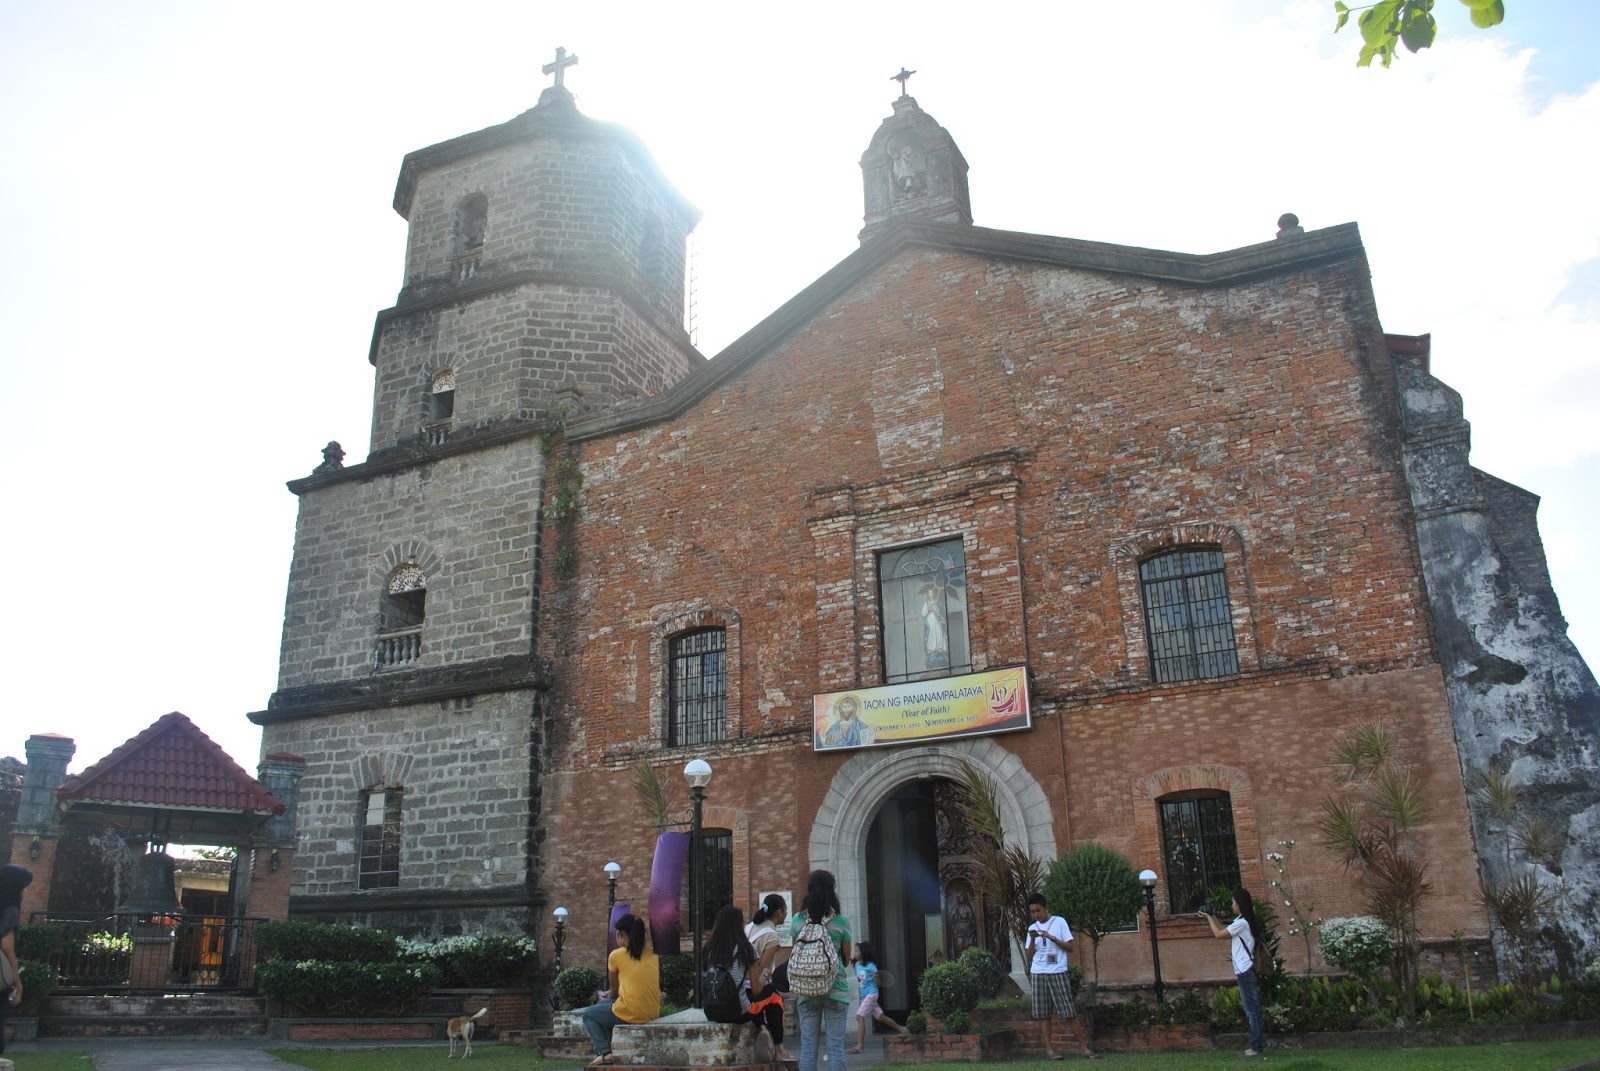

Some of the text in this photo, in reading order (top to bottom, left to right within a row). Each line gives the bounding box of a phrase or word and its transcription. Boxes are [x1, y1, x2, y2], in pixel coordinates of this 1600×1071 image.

[863, 686, 984, 710] TAON NG PANANAMPALATAYA
[901, 704, 951, 719] (Year of Faith)
